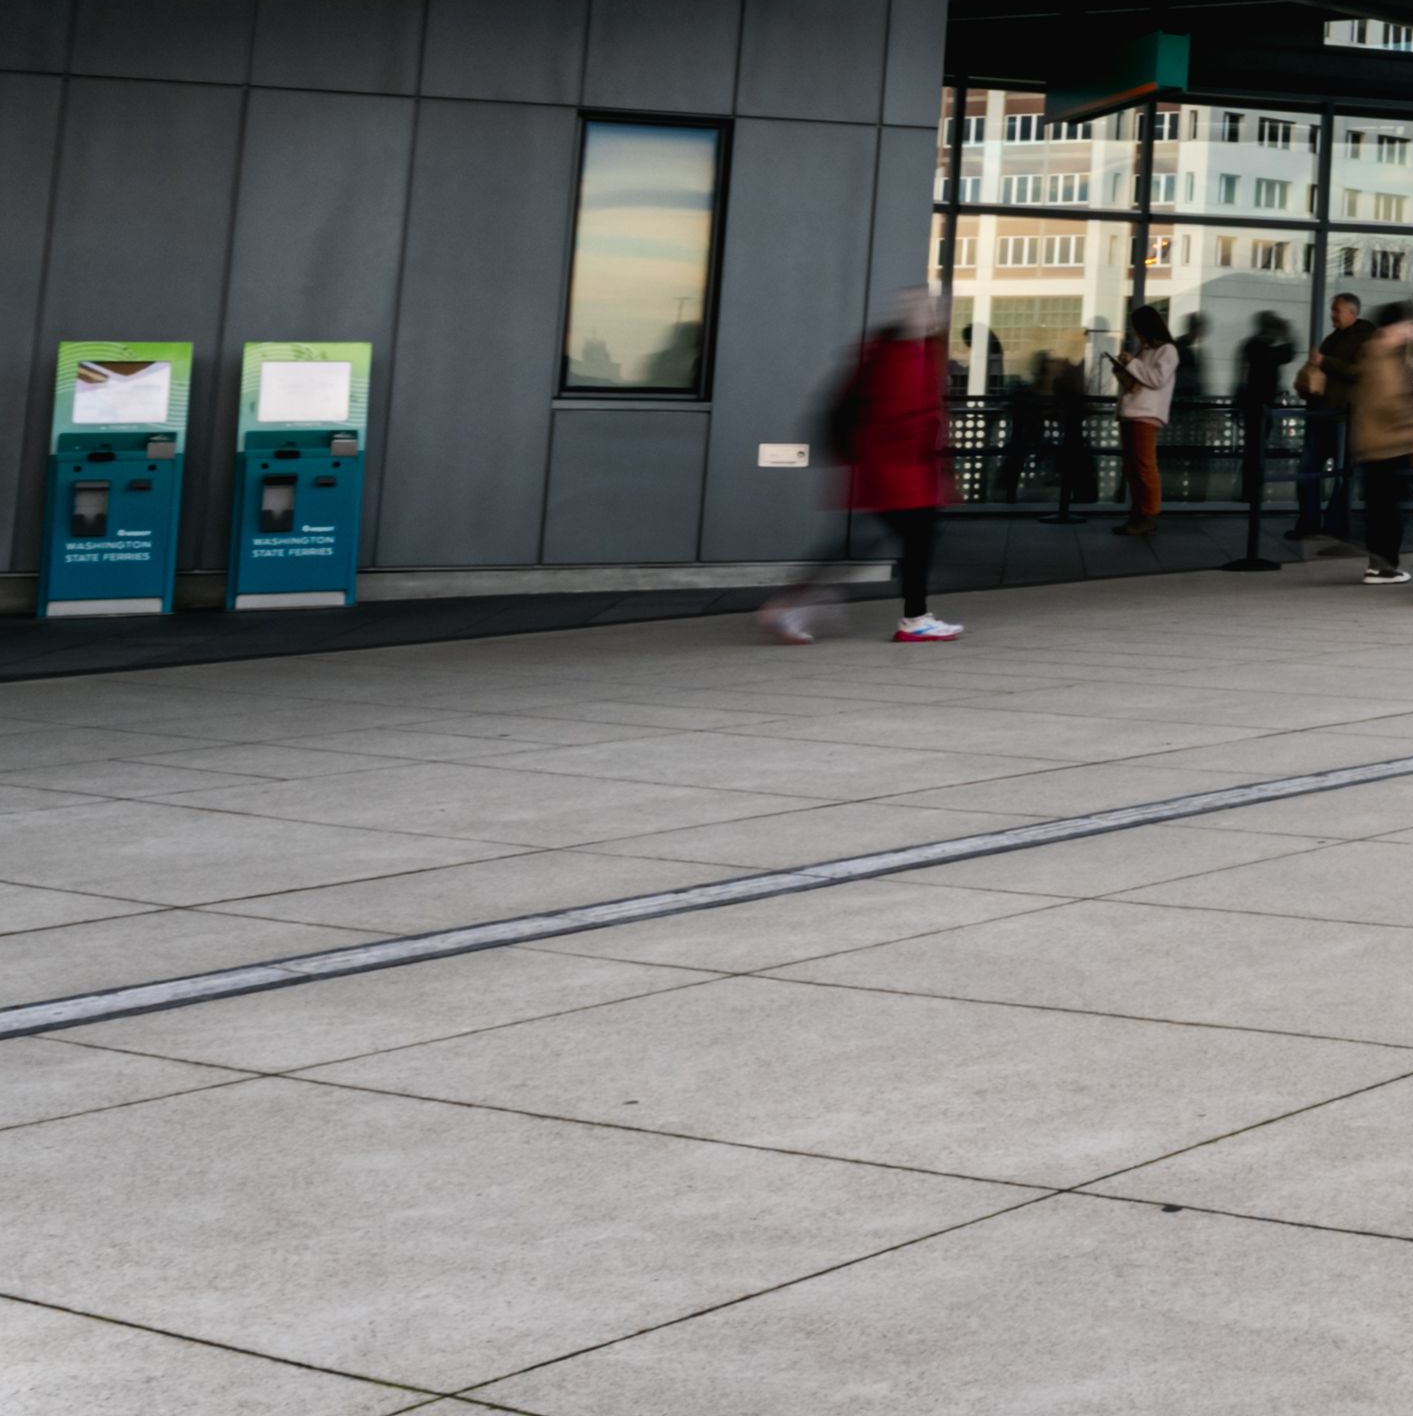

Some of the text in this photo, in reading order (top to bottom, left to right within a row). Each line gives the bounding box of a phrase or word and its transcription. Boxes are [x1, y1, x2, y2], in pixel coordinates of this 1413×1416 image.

[65, 541, 151, 550] WASHINGTON
[253, 536, 334, 545] WASHINGTON
[65, 552, 151, 563] STATE FERRIES
[252, 547, 334, 558] STATE FERRIES
